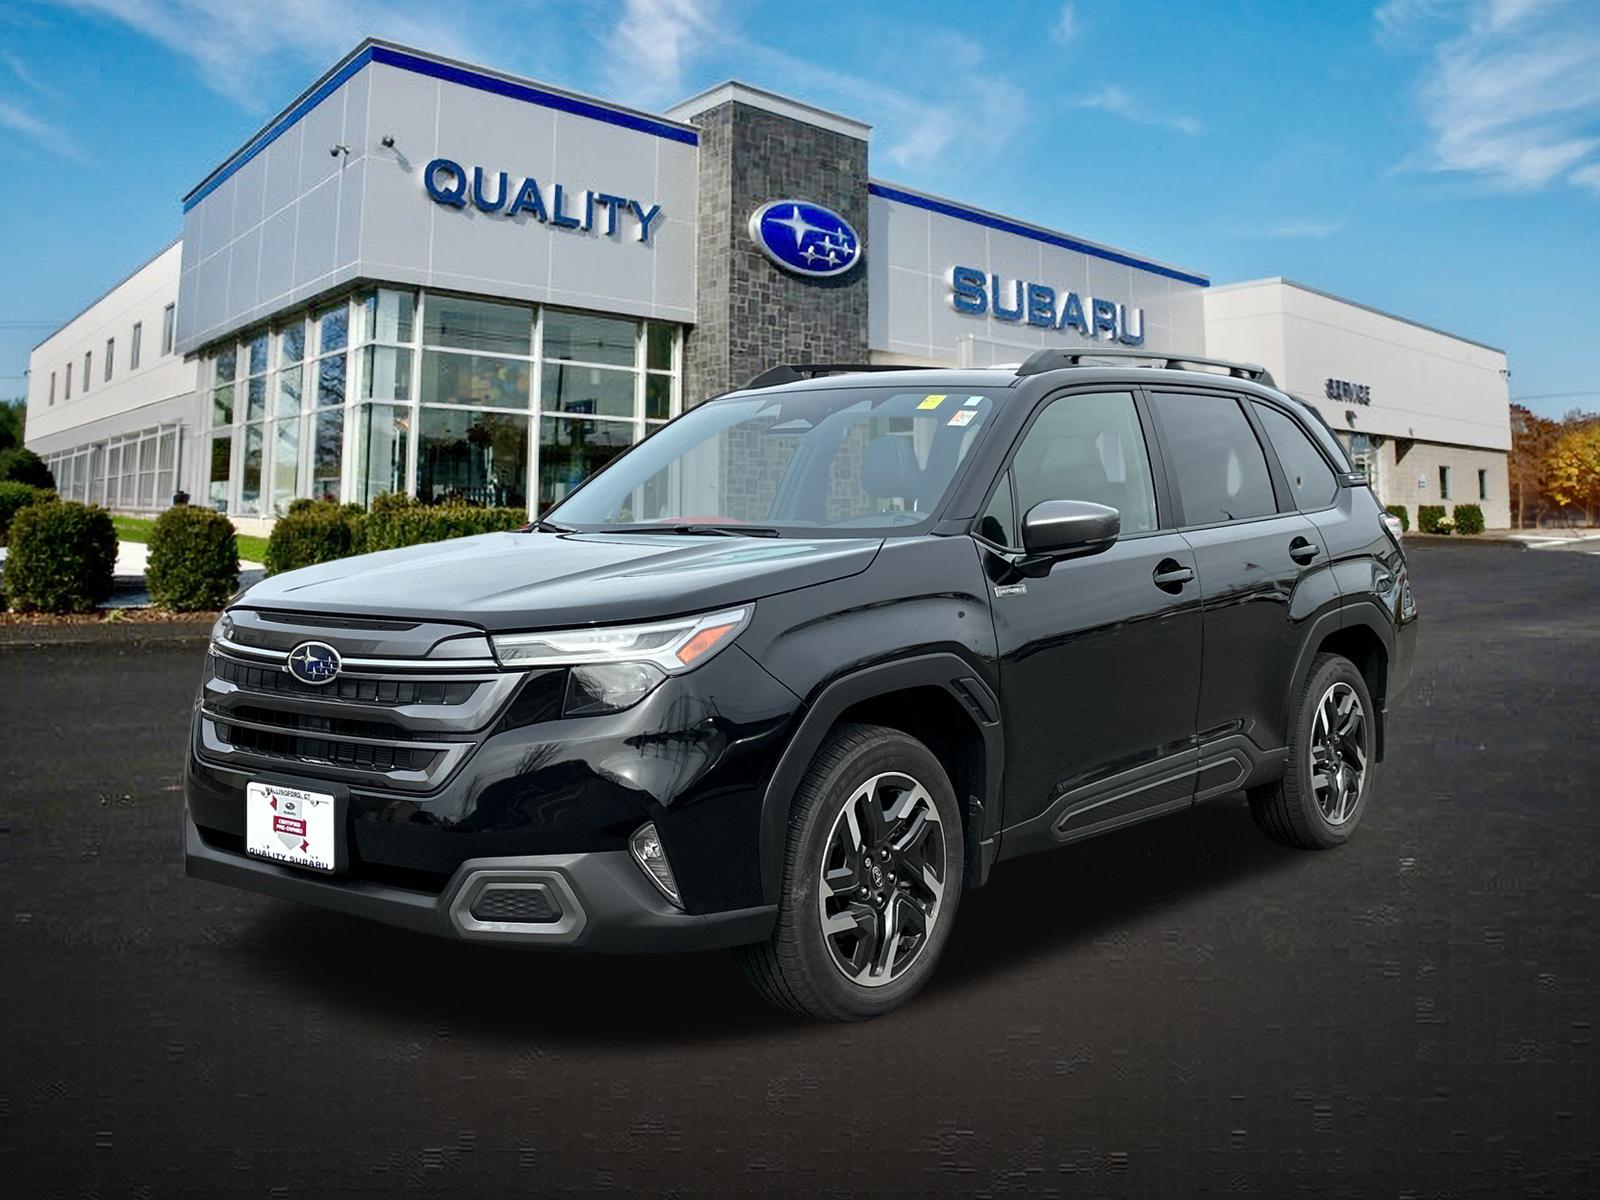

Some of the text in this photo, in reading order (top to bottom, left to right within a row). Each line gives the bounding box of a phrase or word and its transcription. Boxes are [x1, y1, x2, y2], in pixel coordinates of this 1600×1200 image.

[424, 158, 661, 242] QUALITY
[950, 265, 1145, 346] SUBARU
[1324, 377, 1371, 406] SERVICE
[249, 847, 329, 869] QUALITY SUBARU
